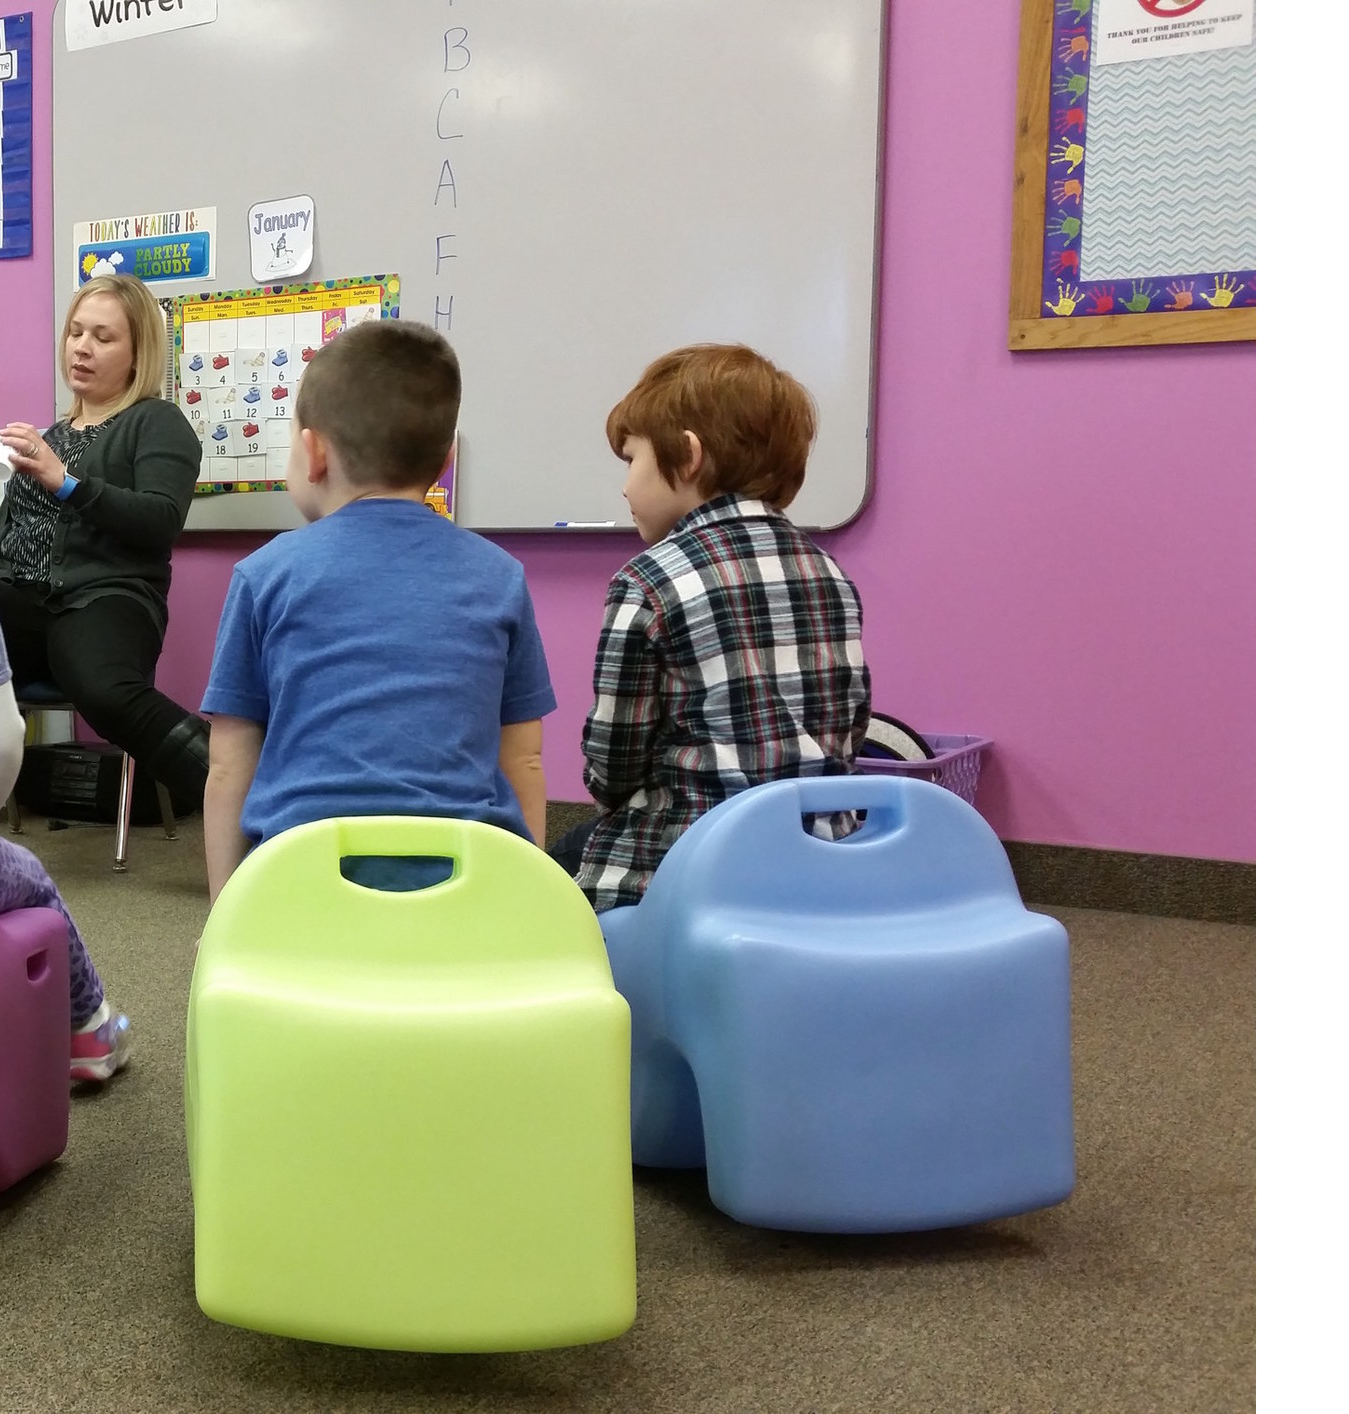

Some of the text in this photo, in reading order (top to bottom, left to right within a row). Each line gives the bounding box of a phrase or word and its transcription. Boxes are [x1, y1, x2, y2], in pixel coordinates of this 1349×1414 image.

[1107, 29, 1134, 39] THANK
[1153, 24, 1169, 33] FOR
[1171, 19, 1206, 31] HELPING
[1220, 14, 1243, 23] KEEP
[1150, 32, 1190, 42] CHILDREN
[444, 27, 471, 73] B
[436, 87, 464, 140] C
[434, 159, 457, 208] A
[90, 210, 199, 243] TODAY'S WEATHER IS:
[253, 209, 311, 236] January
[135, 242, 191, 262] PARTLY
[435, 234, 458, 276] F
[133, 257, 192, 278] CLOUDY
[195, 370, 285, 385] 3 4 5 6
[190, 406, 286, 420] 10 11 12 13
[216, 443, 259, 455] 18 19
